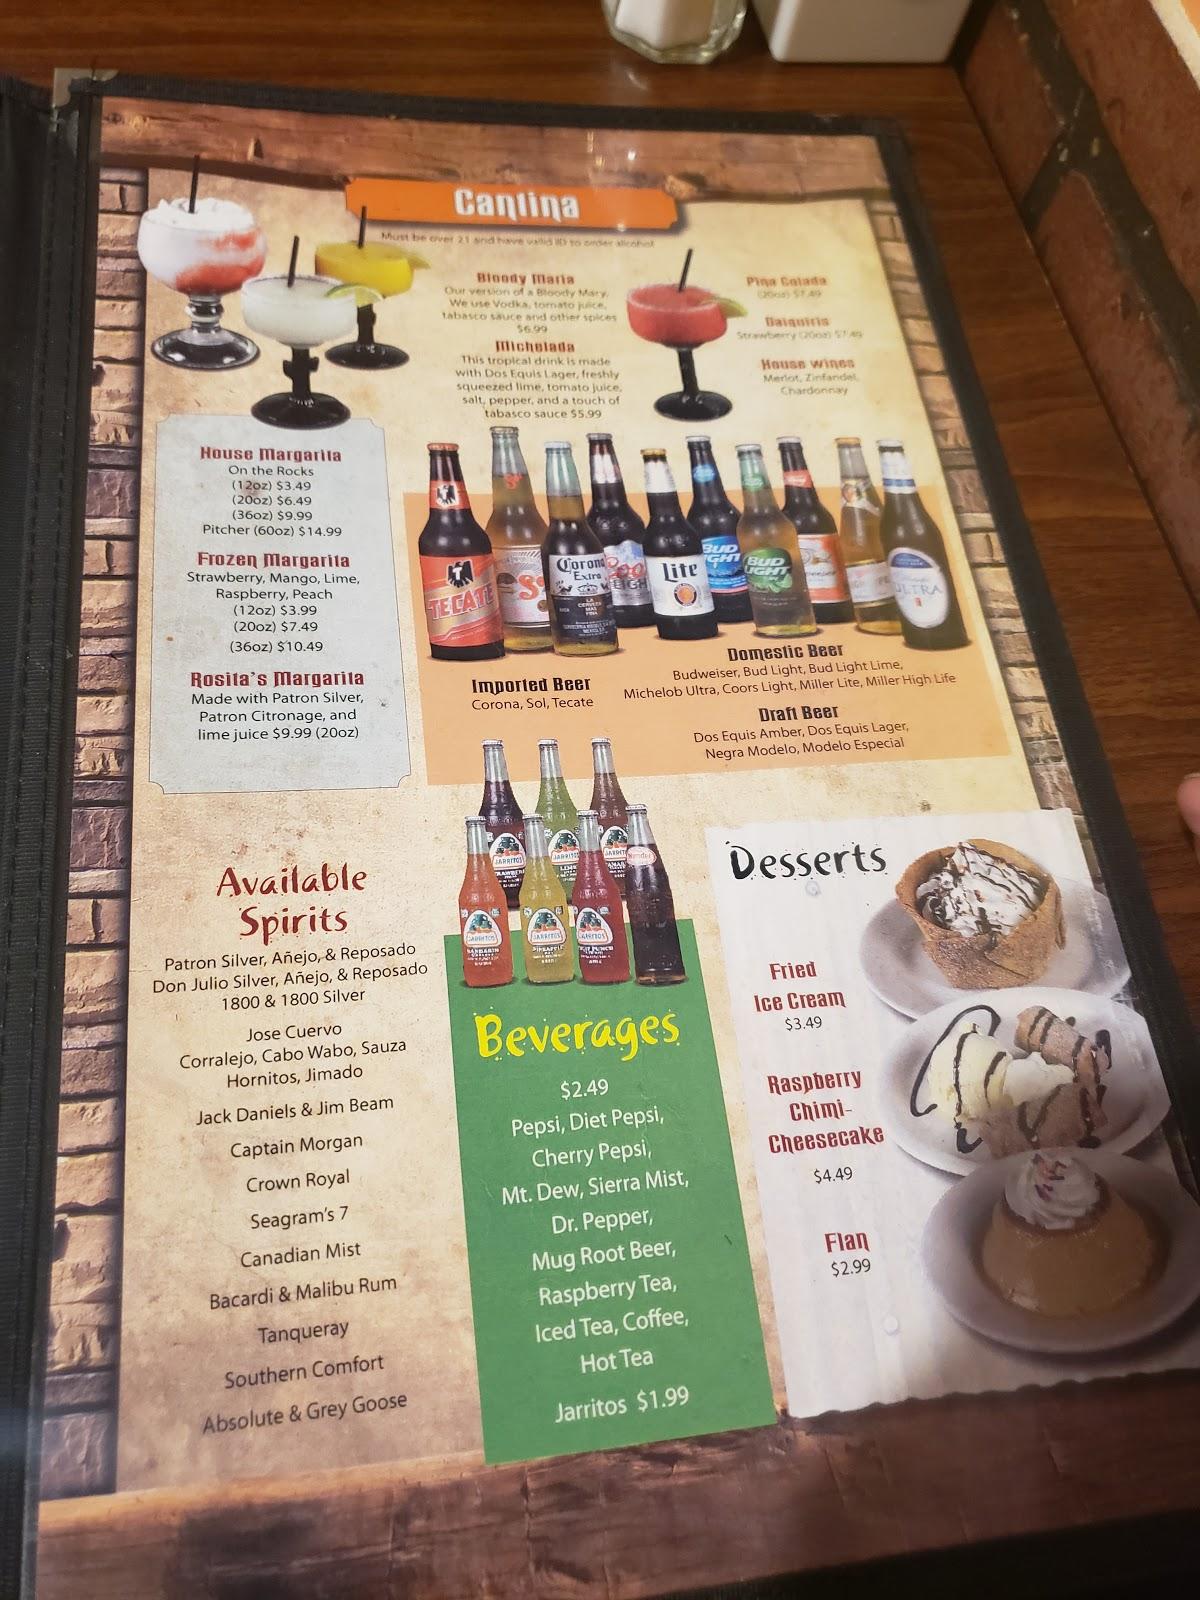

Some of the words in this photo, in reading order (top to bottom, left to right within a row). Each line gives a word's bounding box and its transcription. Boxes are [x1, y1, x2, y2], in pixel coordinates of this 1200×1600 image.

[453, 188, 581, 222] Cantina
[477, 272, 526, 285] Bloody
[531, 274, 574, 285] Maria
[449, 299, 468, 307] We
[493, 300, 532, 310] Vodka,
[534, 301, 576, 310] tomato
[578, 301, 607, 310] juice,
[442, 311, 487, 320] tabasco
[490, 313, 522, 321] sauce
[526, 313, 547, 321] and
[550, 313, 580, 321] other
[583, 313, 617, 322] spices
[765, 316, 829, 328] Daiquiris
[517, 324, 548, 333] $6.99
[496, 341, 575, 352] Michelada
[462, 355, 484, 364] This
[487, 356, 531, 367] tropical
[534, 356, 563, 366] drink
[567, 357, 576, 366] is
[578, 357, 610, 366] made
[761, 359, 806, 371] House
[455, 368, 481, 377] with
[485, 369, 507, 378] Dos
[510, 370, 541, 381] Equis
[545, 370, 579, 381] Lager,
[582, 369, 619, 382] freshly
[763, 374, 802, 384] Merlot,
[457, 382, 514, 392] squeezed
[514, 381, 546, 393] lime,
[547, 383, 589, 393] tomato
[591, 383, 623, 395] juice,
[780, 386, 848, 396] Chardonnay
[485, 408, 531, 418] tabasco
[570, 409, 602, 418] $5.99
[201, 446, 253, 460] House
[259, 448, 341, 463] Margarita
[228, 465, 248, 475] On
[252, 465, 273, 476] the
[277, 466, 314, 476] Rocks
[232, 481, 273, 491] (12oz)
[276, 480, 311, 491] $3.49
[203, 524, 250, 535] Pitcher
[254, 525, 294, 537] (60oz)
[299, 526, 342, 537] $14.99
[198, 552, 258, 569] Frozen
[264, 553, 350, 569] Margarita
[747, 556, 785, 566] BUD
[187, 571, 265, 585] Strawberry,
[270, 573, 320, 586] Mango,
[324, 573, 360, 584] Lime,
[661, 562, 698, 582] Lite
[745, 566, 790, 576] LIGHT
[216, 588, 288, 602] Raspberry,
[293, 589, 333, 599] Peach
[428, 582, 494, 620] TECATE
[230, 641, 273, 653] (36oz)
[277, 641, 323, 653] $10.49
[727, 645, 804, 661] Domestic
[807, 644, 843, 657] Beer
[673, 668, 740, 680] Budweiser,
[743, 665, 768, 677] Bud
[770, 663, 806, 679] Light,
[808, 662, 833, 674] Bud
[835, 661, 868, 674] Light
[870, 660, 903, 670] Lime,
[274, 671, 364, 688] Margarita
[472, 678, 548, 696] Imported
[553, 677, 590, 691] Beer
[624, 686, 683, 699] Michelob
[686, 685, 719, 696] Ultra,
[722, 683, 759, 694] Coors
[761, 680, 797, 694] Light,
[800, 679, 834, 690] Miller
[837, 677, 863, 688] Lite,
[865, 675, 900, 686] Miller
[902, 674, 932, 687] High
[933, 673, 956, 684] Life
[472, 699, 523, 710] Corona,
[526, 697, 549, 709] Sol,
[551, 697, 594, 708] Tecate
[200, 711, 247, 722] Patron
[251, 710, 326, 724] Citronage,
[330, 708, 356, 720] and
[758, 707, 798, 722] Draft
[801, 706, 838, 719] Beer
[198, 729, 230, 740] lime
[233, 728, 269, 743] juice
[273, 727, 312, 740] $9.99
[316, 726, 359, 740] (20oz)
[693, 732, 719, 743] Dos
[721, 730, 756, 743] Equis
[760, 727, 805, 739] Amber,
[807, 725, 832, 736] Dos
[834, 723, 869, 736] Equis
[871, 722, 909, 734] Lager,
[706, 748, 744, 761] Negra
[748, 744, 800, 757] Modelo,
[802, 740, 851, 753] Modelo
[853, 737, 904, 751] Especial
[730, 844, 888, 880] Desserts
[216, 862, 367, 897] Available
[239, 906, 347, 946] Spirits
[222, 996, 260, 1010] 1800
[264, 994, 276, 1008] &
[281, 992, 319, 1006] 1800
[323, 989, 365, 1003] Silver
[754, 995, 783, 1012] Ice
[787, 992, 846, 1009] Cream
[785, 1016, 822, 1031] $3.49
[246, 1028, 281, 1042] Jose
[285, 1025, 342, 1039] Cuervo
[473, 1012, 680, 1061] Beverages
[227, 1071, 300, 1088] Hornitos,
[305, 1064, 363, 1082] Jimado
[561, 1079, 608, 1100] $2.49
[230, 1139, 294, 1160] Captain
[300, 1136, 363, 1153] Morgan
[768, 1126, 884, 1154] Cheesecake
[532, 1148, 594, 1167] Cherry
[599, 1139, 651, 1163] Pepsi,
[552, 1215, 578, 1234] Dr.
[583, 1210, 653, 1232] Pepper,
[824, 1233, 870, 1253] Flan
[831, 1258, 871, 1278] $2.99
[257, 1322, 349, 1344] Tanqueray
[225, 1363, 308, 1390] Southern
[312, 1355, 384, 1378] Comfort
[555, 1398, 627, 1423] Jarritos
[637, 1385, 689, 1412] $1.99
